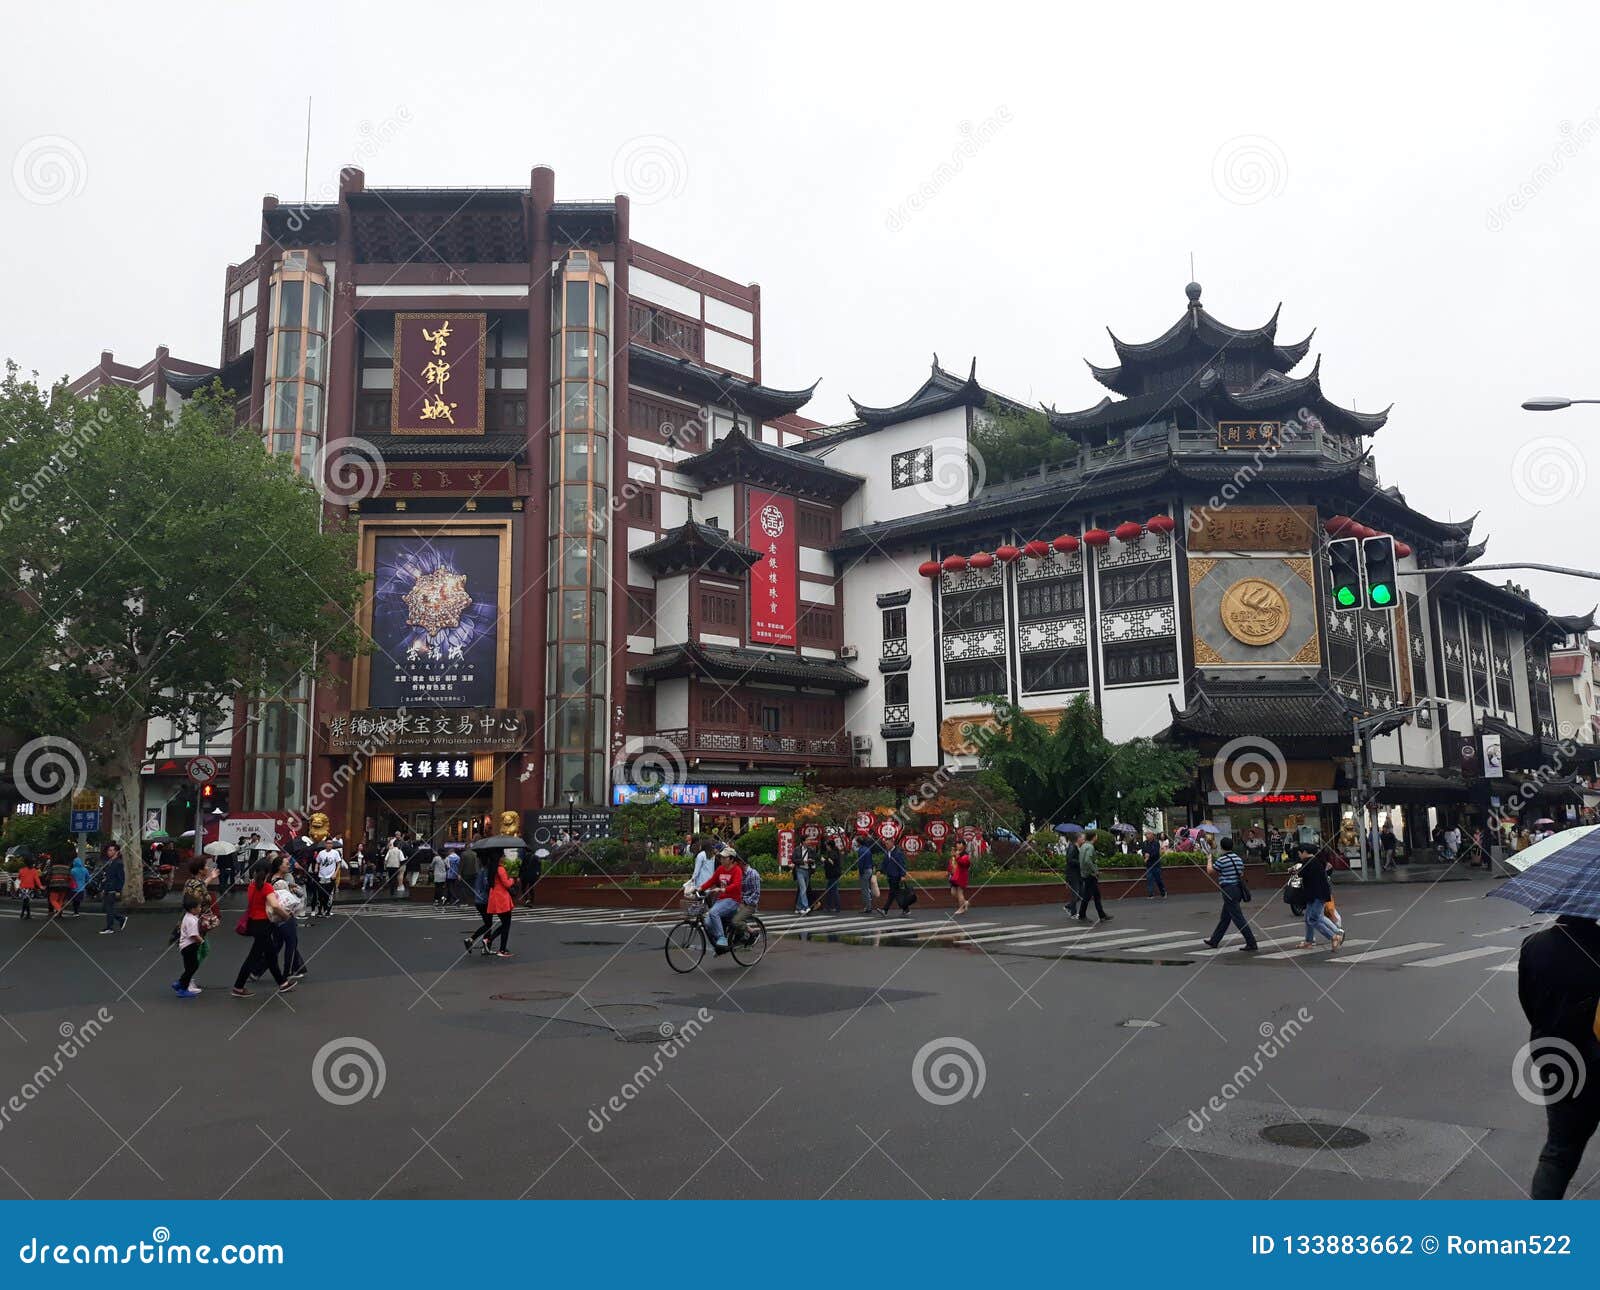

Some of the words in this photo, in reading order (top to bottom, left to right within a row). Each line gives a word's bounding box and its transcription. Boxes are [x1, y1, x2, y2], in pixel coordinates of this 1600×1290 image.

[331, 715, 519, 737] 紫锦城珠宝交易中心
[399, 760, 469, 778] 东华美钻
